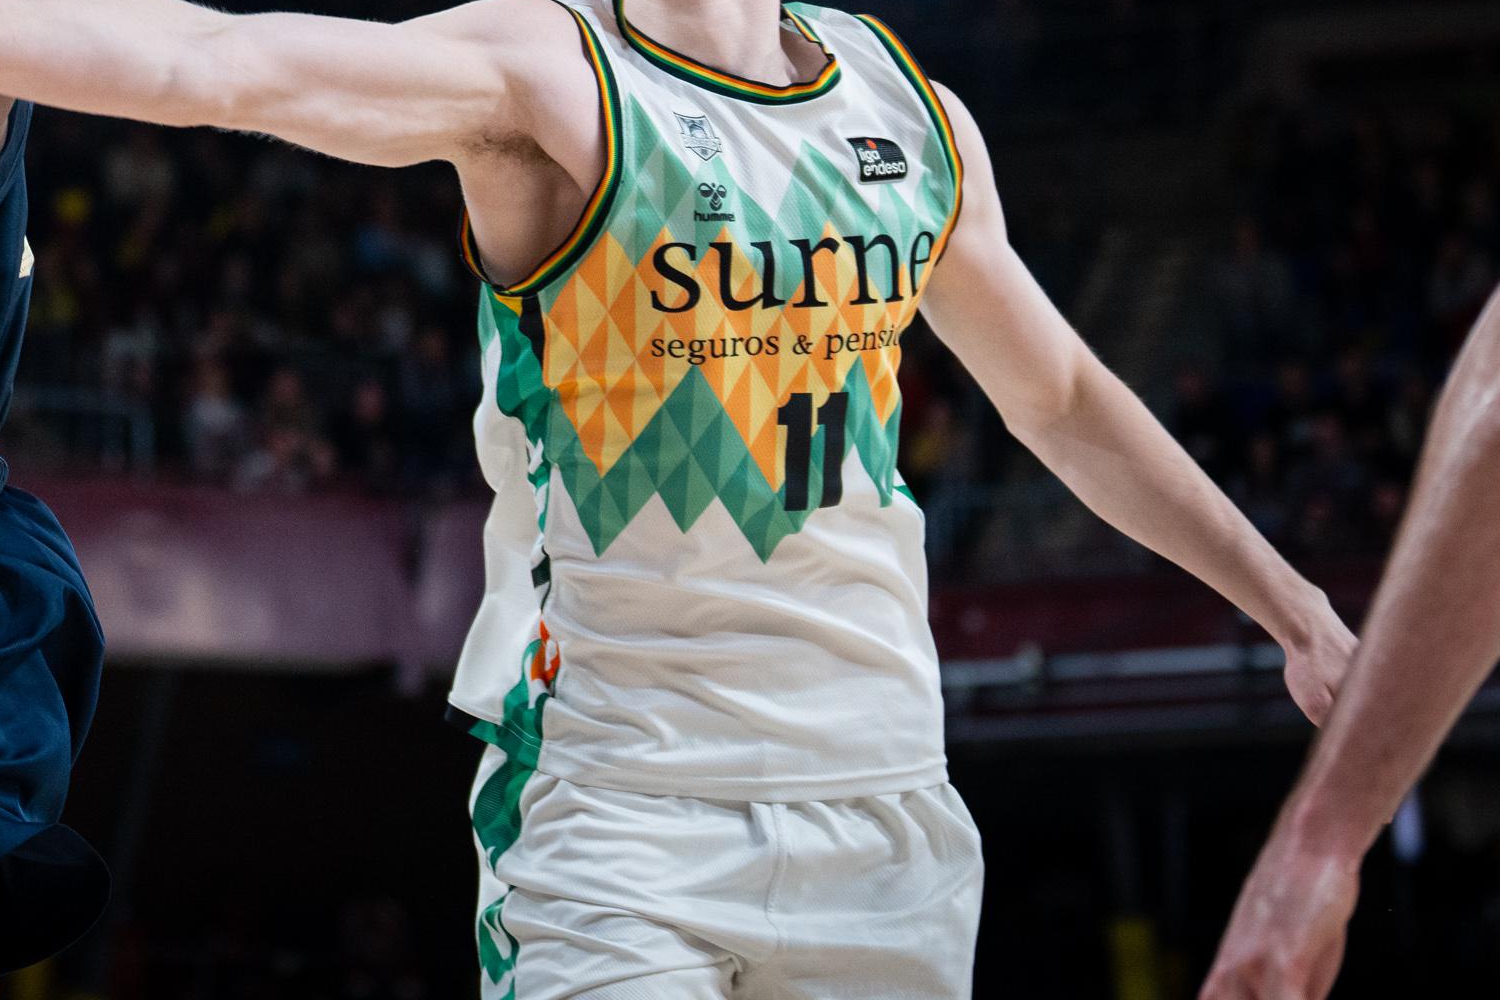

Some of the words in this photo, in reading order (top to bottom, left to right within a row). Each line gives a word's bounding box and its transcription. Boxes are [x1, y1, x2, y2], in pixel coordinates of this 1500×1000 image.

[857, 148, 881, 163] liga
[863, 160, 906, 176] endesa
[650, 230, 935, 314] surne
[651, 334, 780, 366] seguros
[792, 334, 813, 355] &
[777, 391, 849, 511] 11
